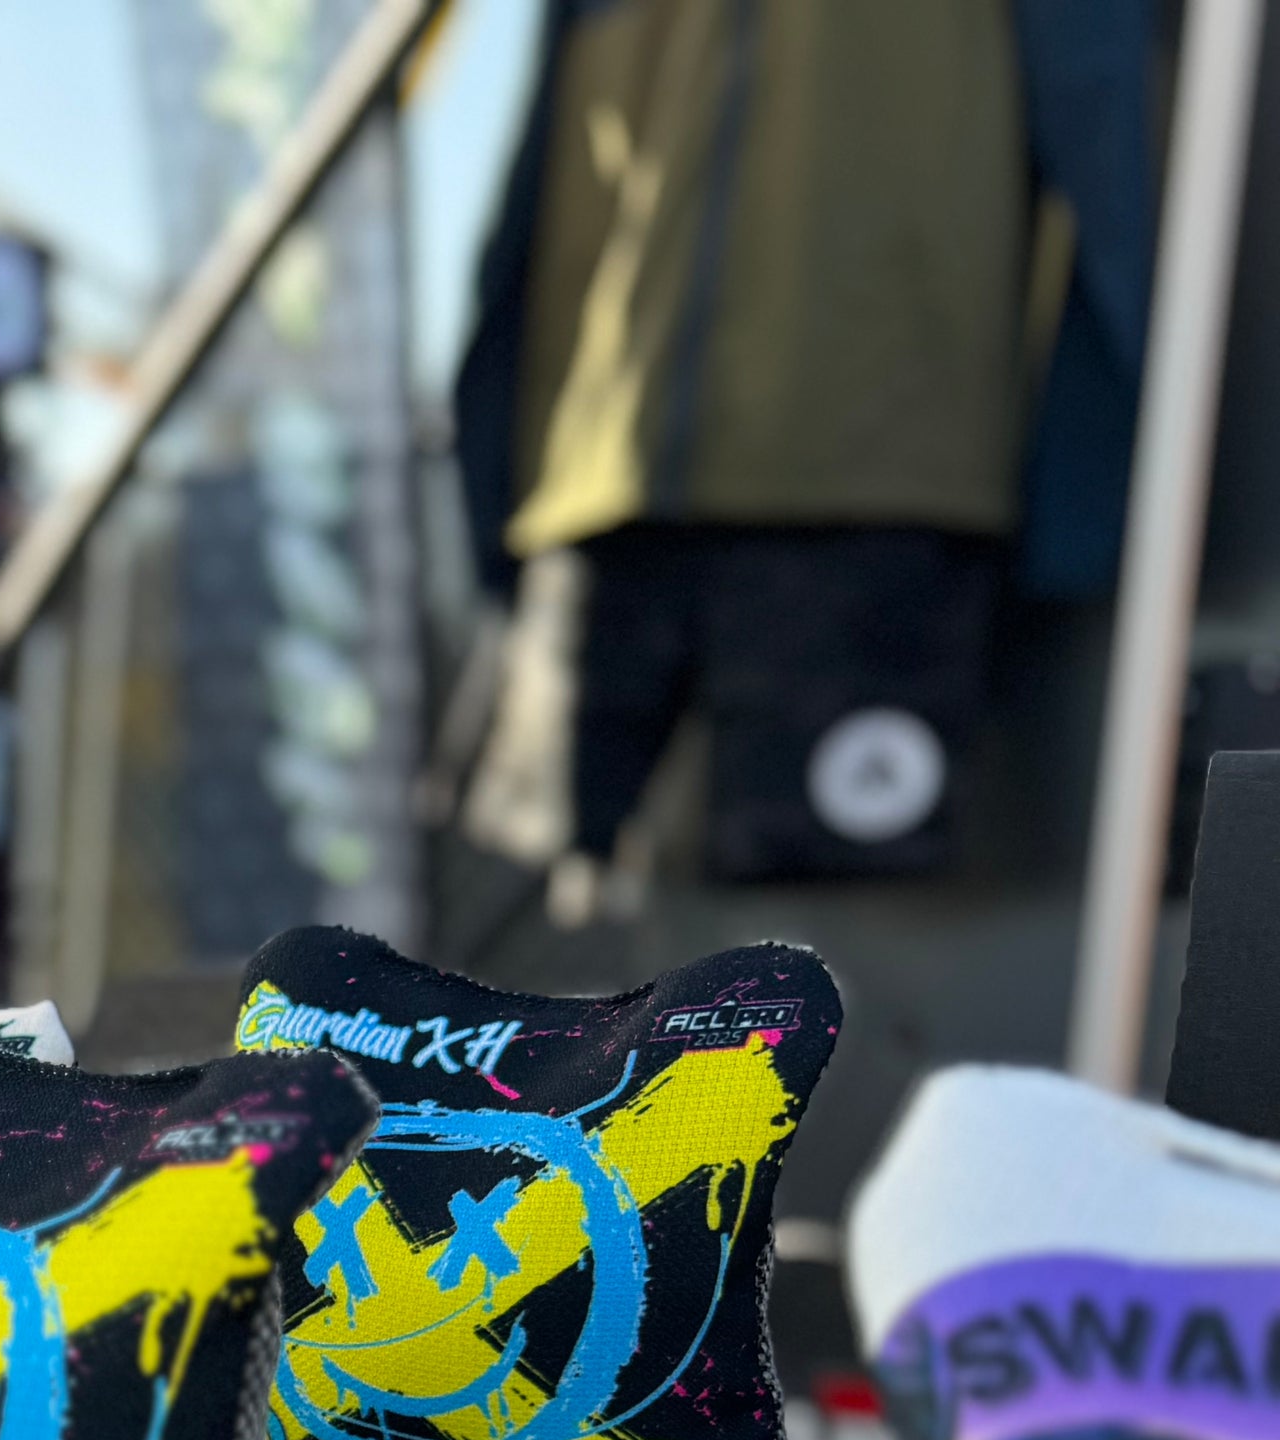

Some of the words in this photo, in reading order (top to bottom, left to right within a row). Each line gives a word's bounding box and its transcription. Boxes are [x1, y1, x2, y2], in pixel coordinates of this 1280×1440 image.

[240, 990, 414, 1065] Guardian
[411, 1015, 523, 1076] XH
[693, 1029, 742, 1046] 2025
[736, 1006, 790, 1029] PRO
[947, 1295, 1280, 1402] SWA
